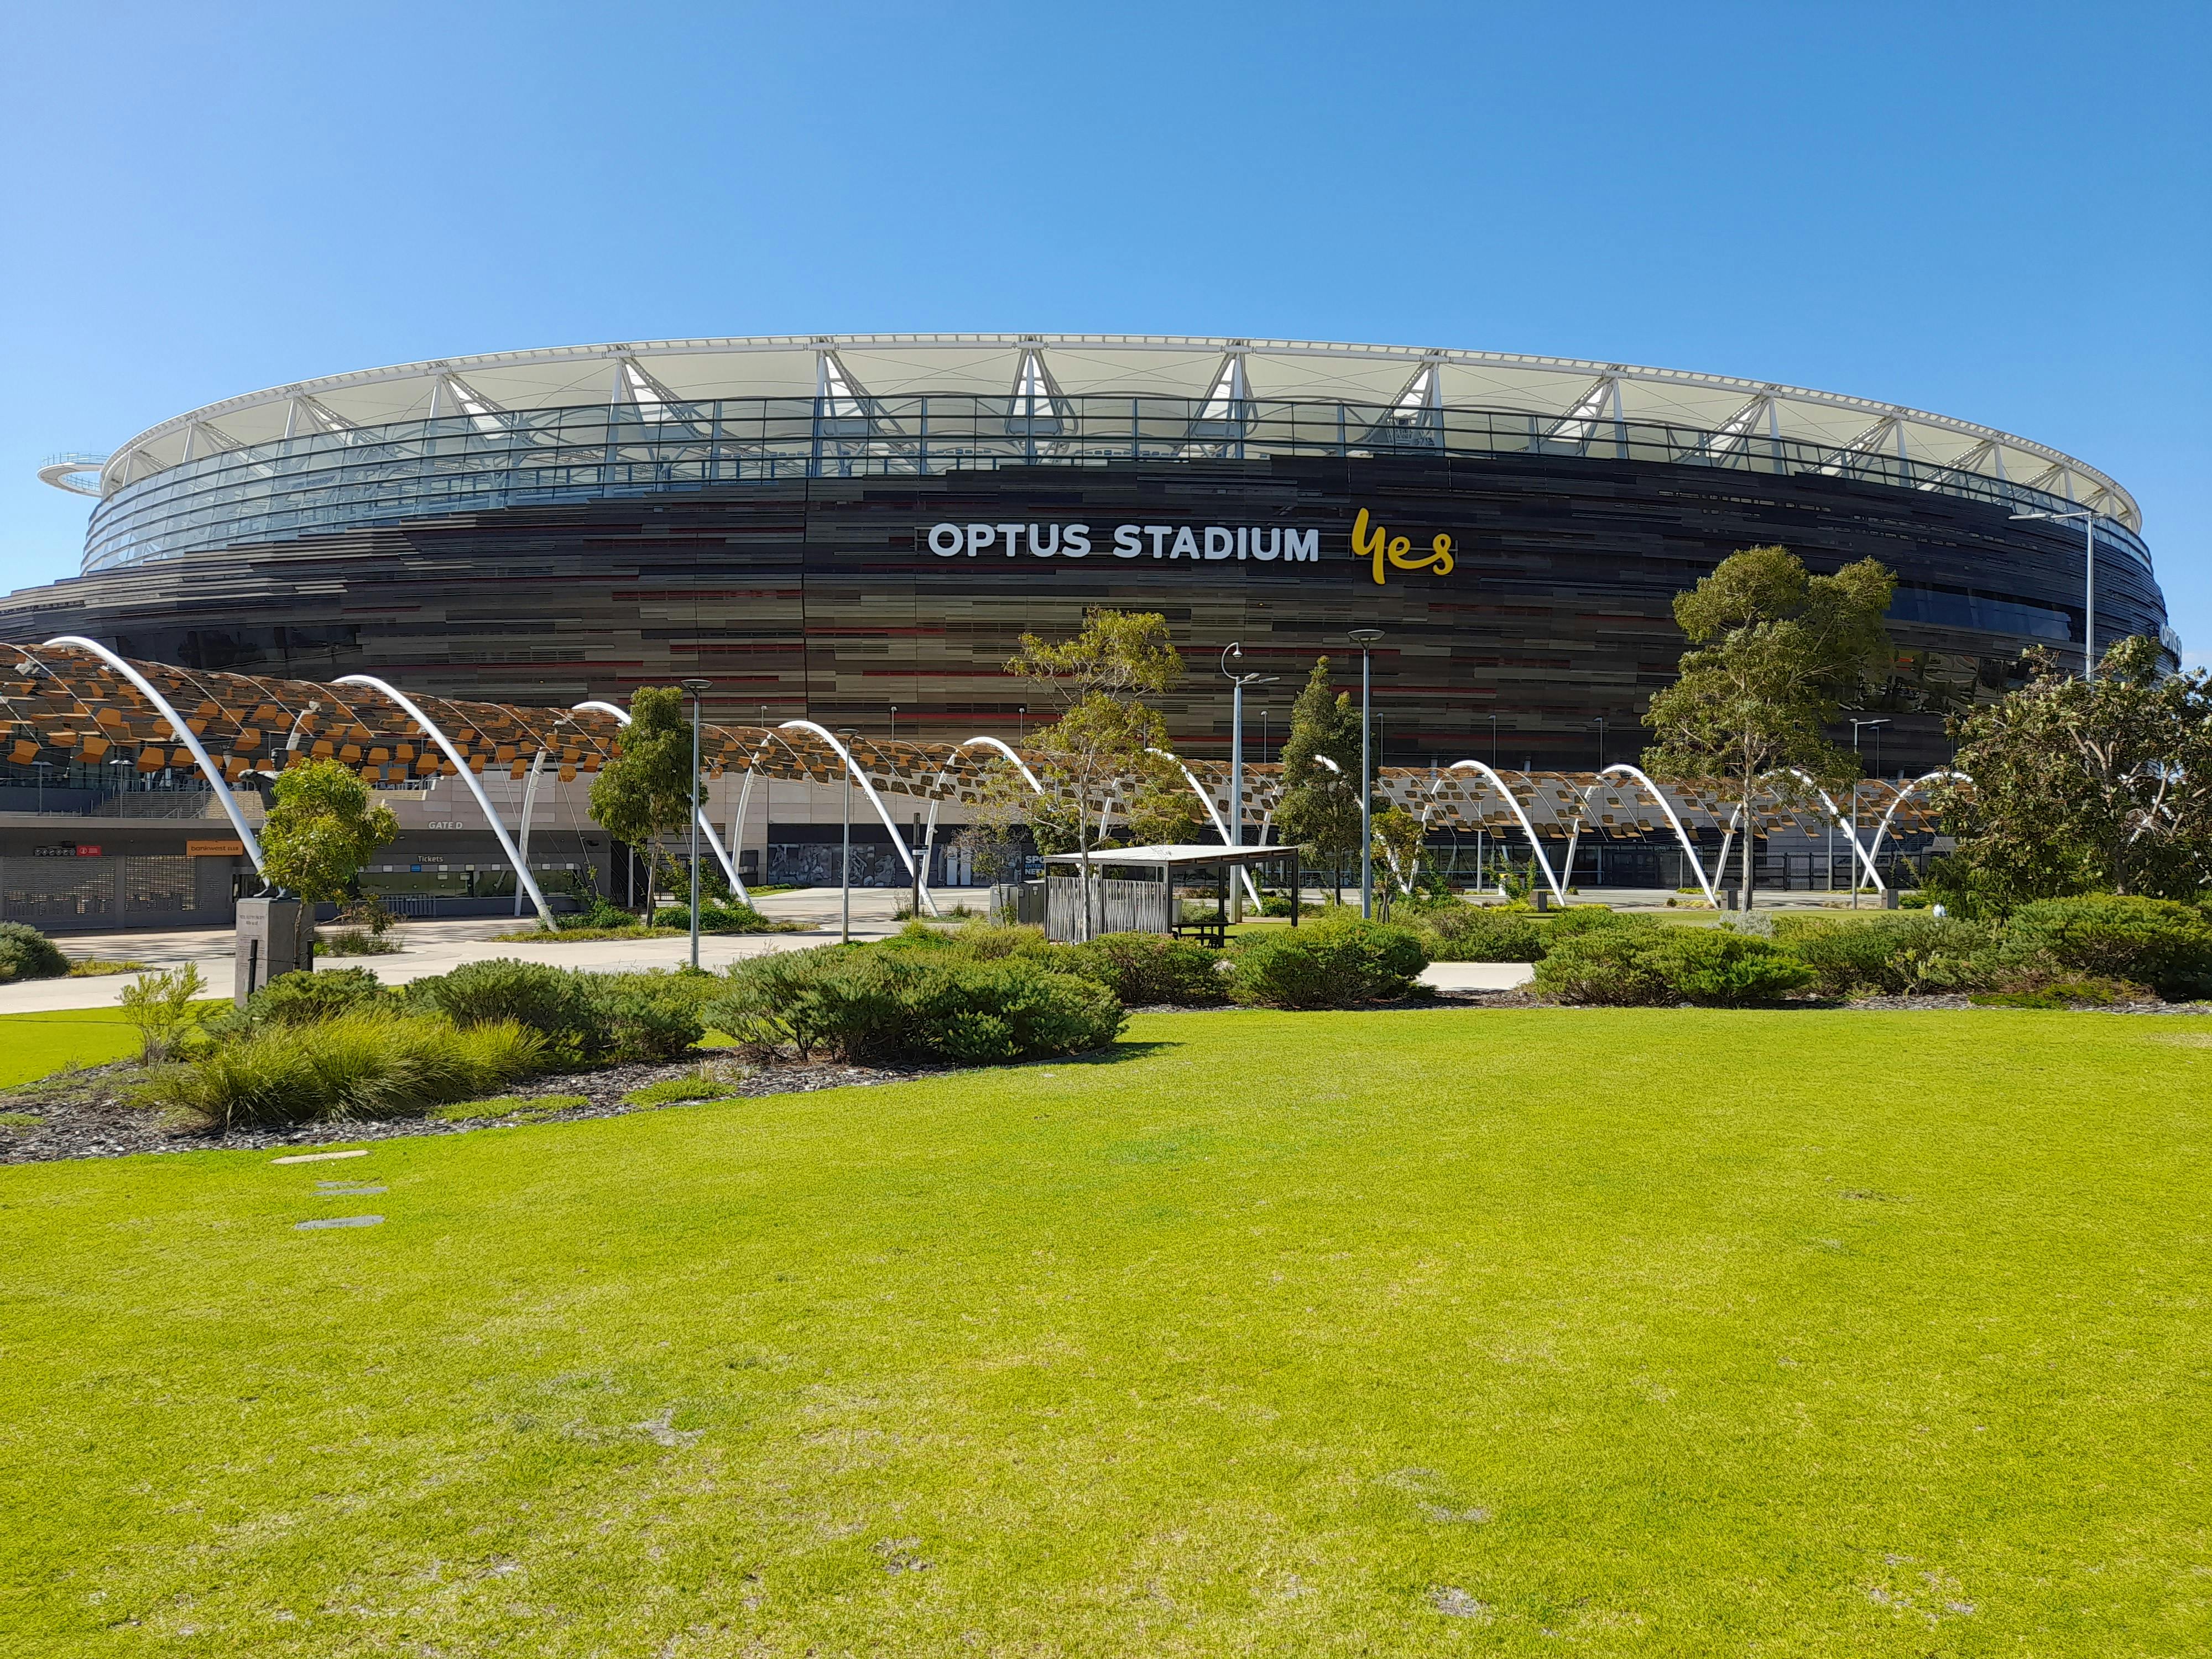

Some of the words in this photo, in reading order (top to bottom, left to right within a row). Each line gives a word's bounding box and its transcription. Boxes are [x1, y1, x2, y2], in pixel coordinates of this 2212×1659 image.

[928, 523, 1092, 559] OPTUS
[1112, 524, 1319, 562] STADIUM
[1351, 507, 1454, 585] yes
